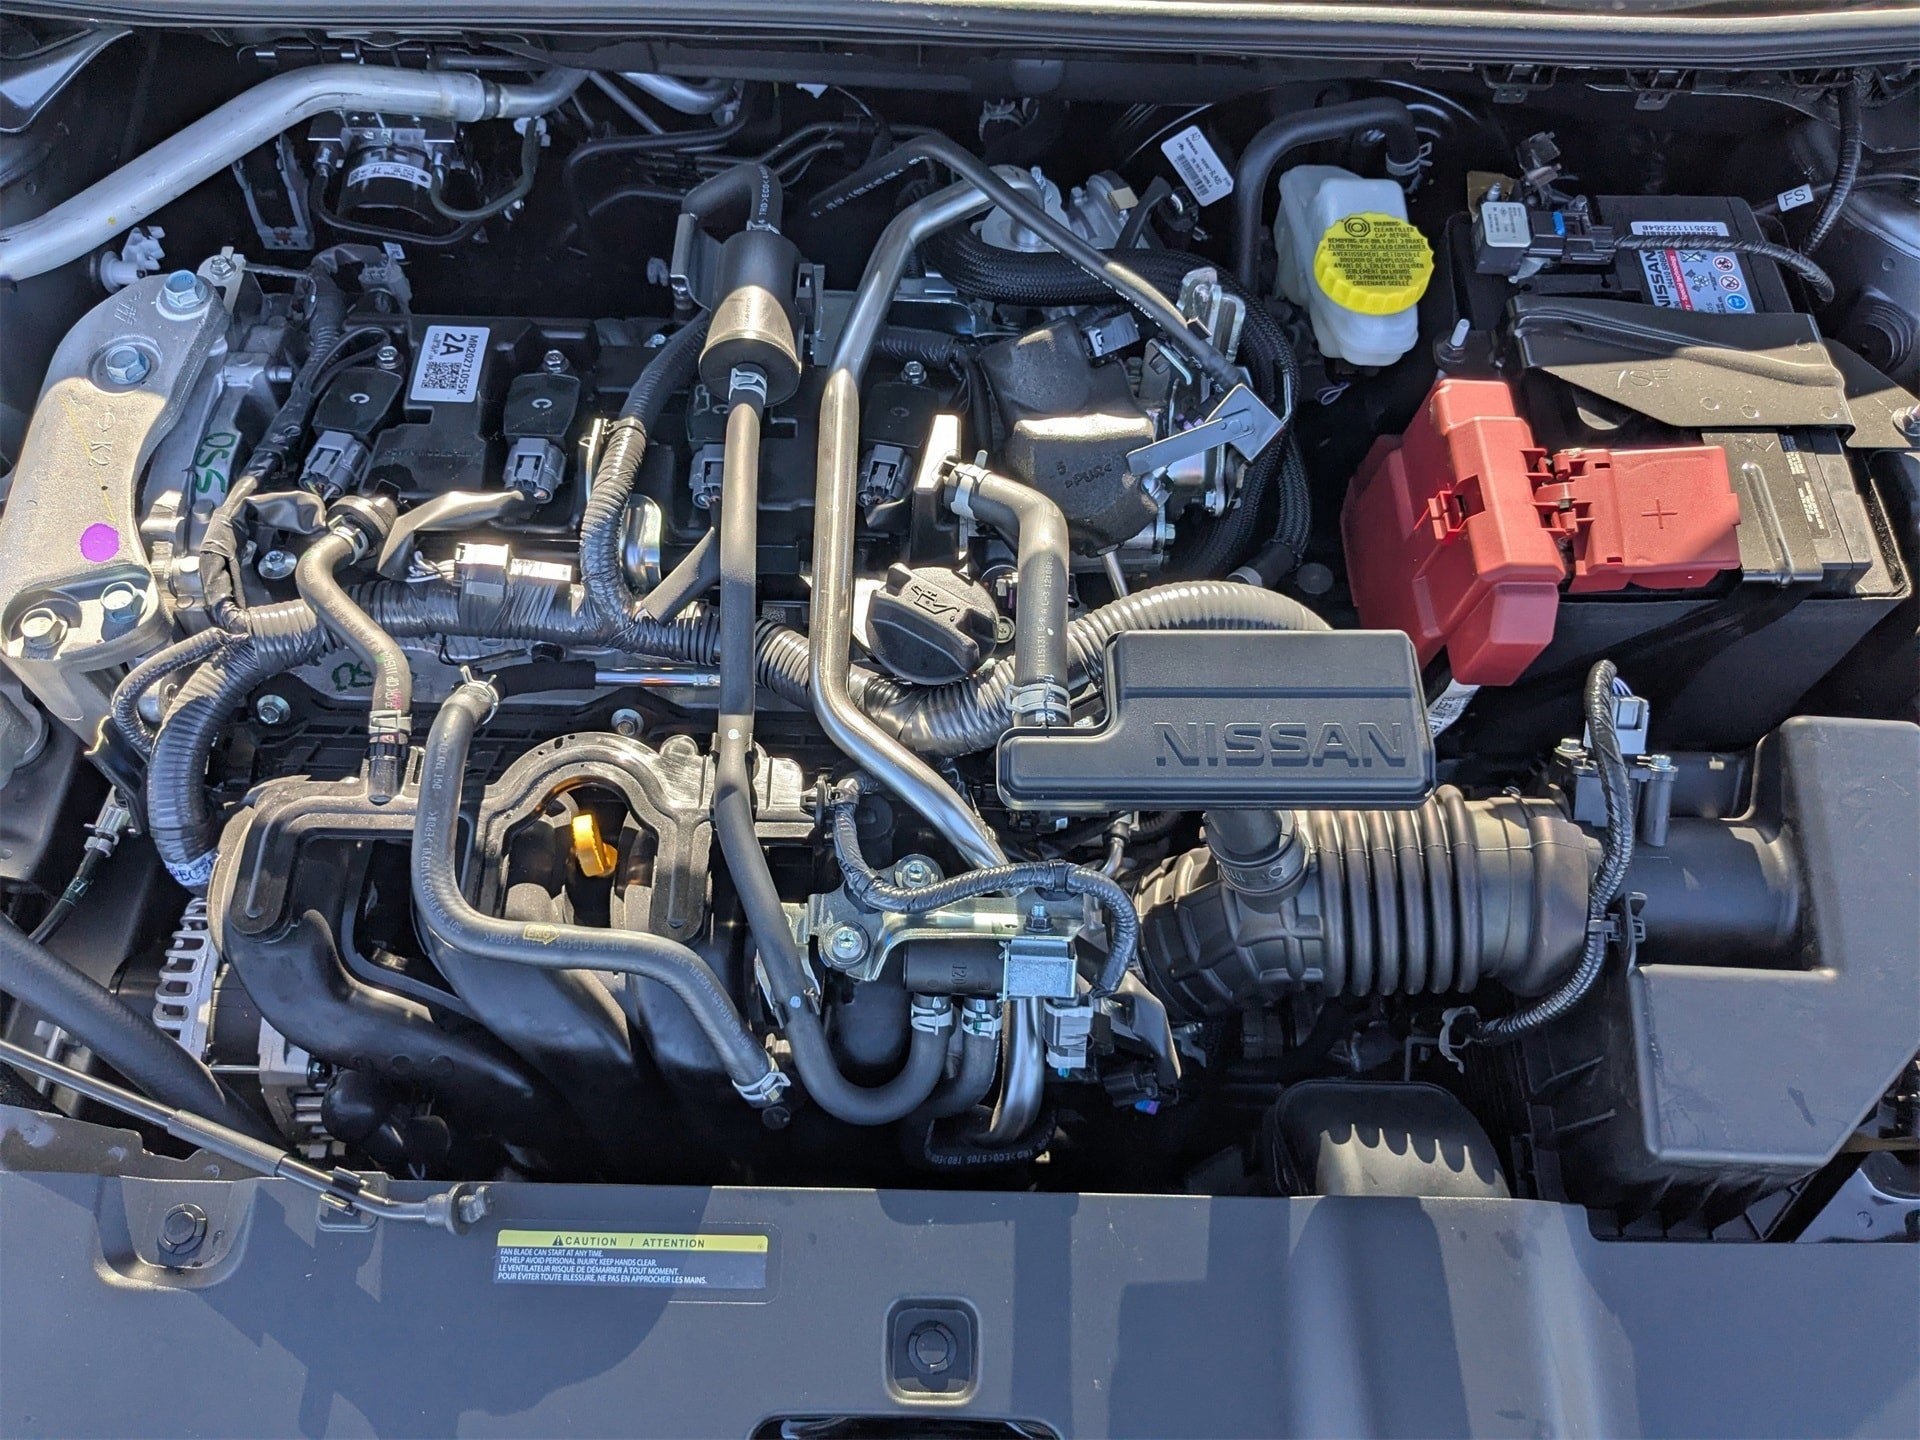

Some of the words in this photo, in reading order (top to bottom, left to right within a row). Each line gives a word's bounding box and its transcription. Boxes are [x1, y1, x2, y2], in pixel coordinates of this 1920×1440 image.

[1783, 189, 1806, 206] FS
[440, 332, 468, 356] 2A
[1153, 722, 1406, 767] NISSAN
[566, 1236, 617, 1246] CAUTION
[642, 1238, 705, 1248] ATTENTION
[513, 1248, 533, 1256] BLADE
[533, 1248, 547, 1256] CAN
[548, 1249, 565, 1257] START
[501, 1256, 509, 1264] TO
[510, 1256, 525, 1264] HELP
[545, 1257, 576, 1265] PERSONAL
[599, 1258, 614, 1266] KEEP
[615, 1258, 636, 1266] HANDS
[499, 1264, 507, 1272] LE
[508, 1264, 550, 1273] VENTILATEUR
[551, 1265, 575, 1274] RISQUE
[587, 1264, 622, 1274] DÉMARRER
[629, 1266, 647, 1274] TOUT
[648, 1267, 680, 1275] MOMENT.
[498, 1272, 516, 1280] POUR
[518, 1271, 540, 1280] ÉVITER
[563, 1273, 596, 1282] BLESSURE,
[597, 1274, 609, 1282] NE
[610, 1274, 620, 1282] PAS
[620, 1274, 629, 1282] EN
[630, 1275, 670, 1283] APPROCHER
[672, 1276, 683, 1284] LES
[684, 1276, 708, 1284] MAINS.
